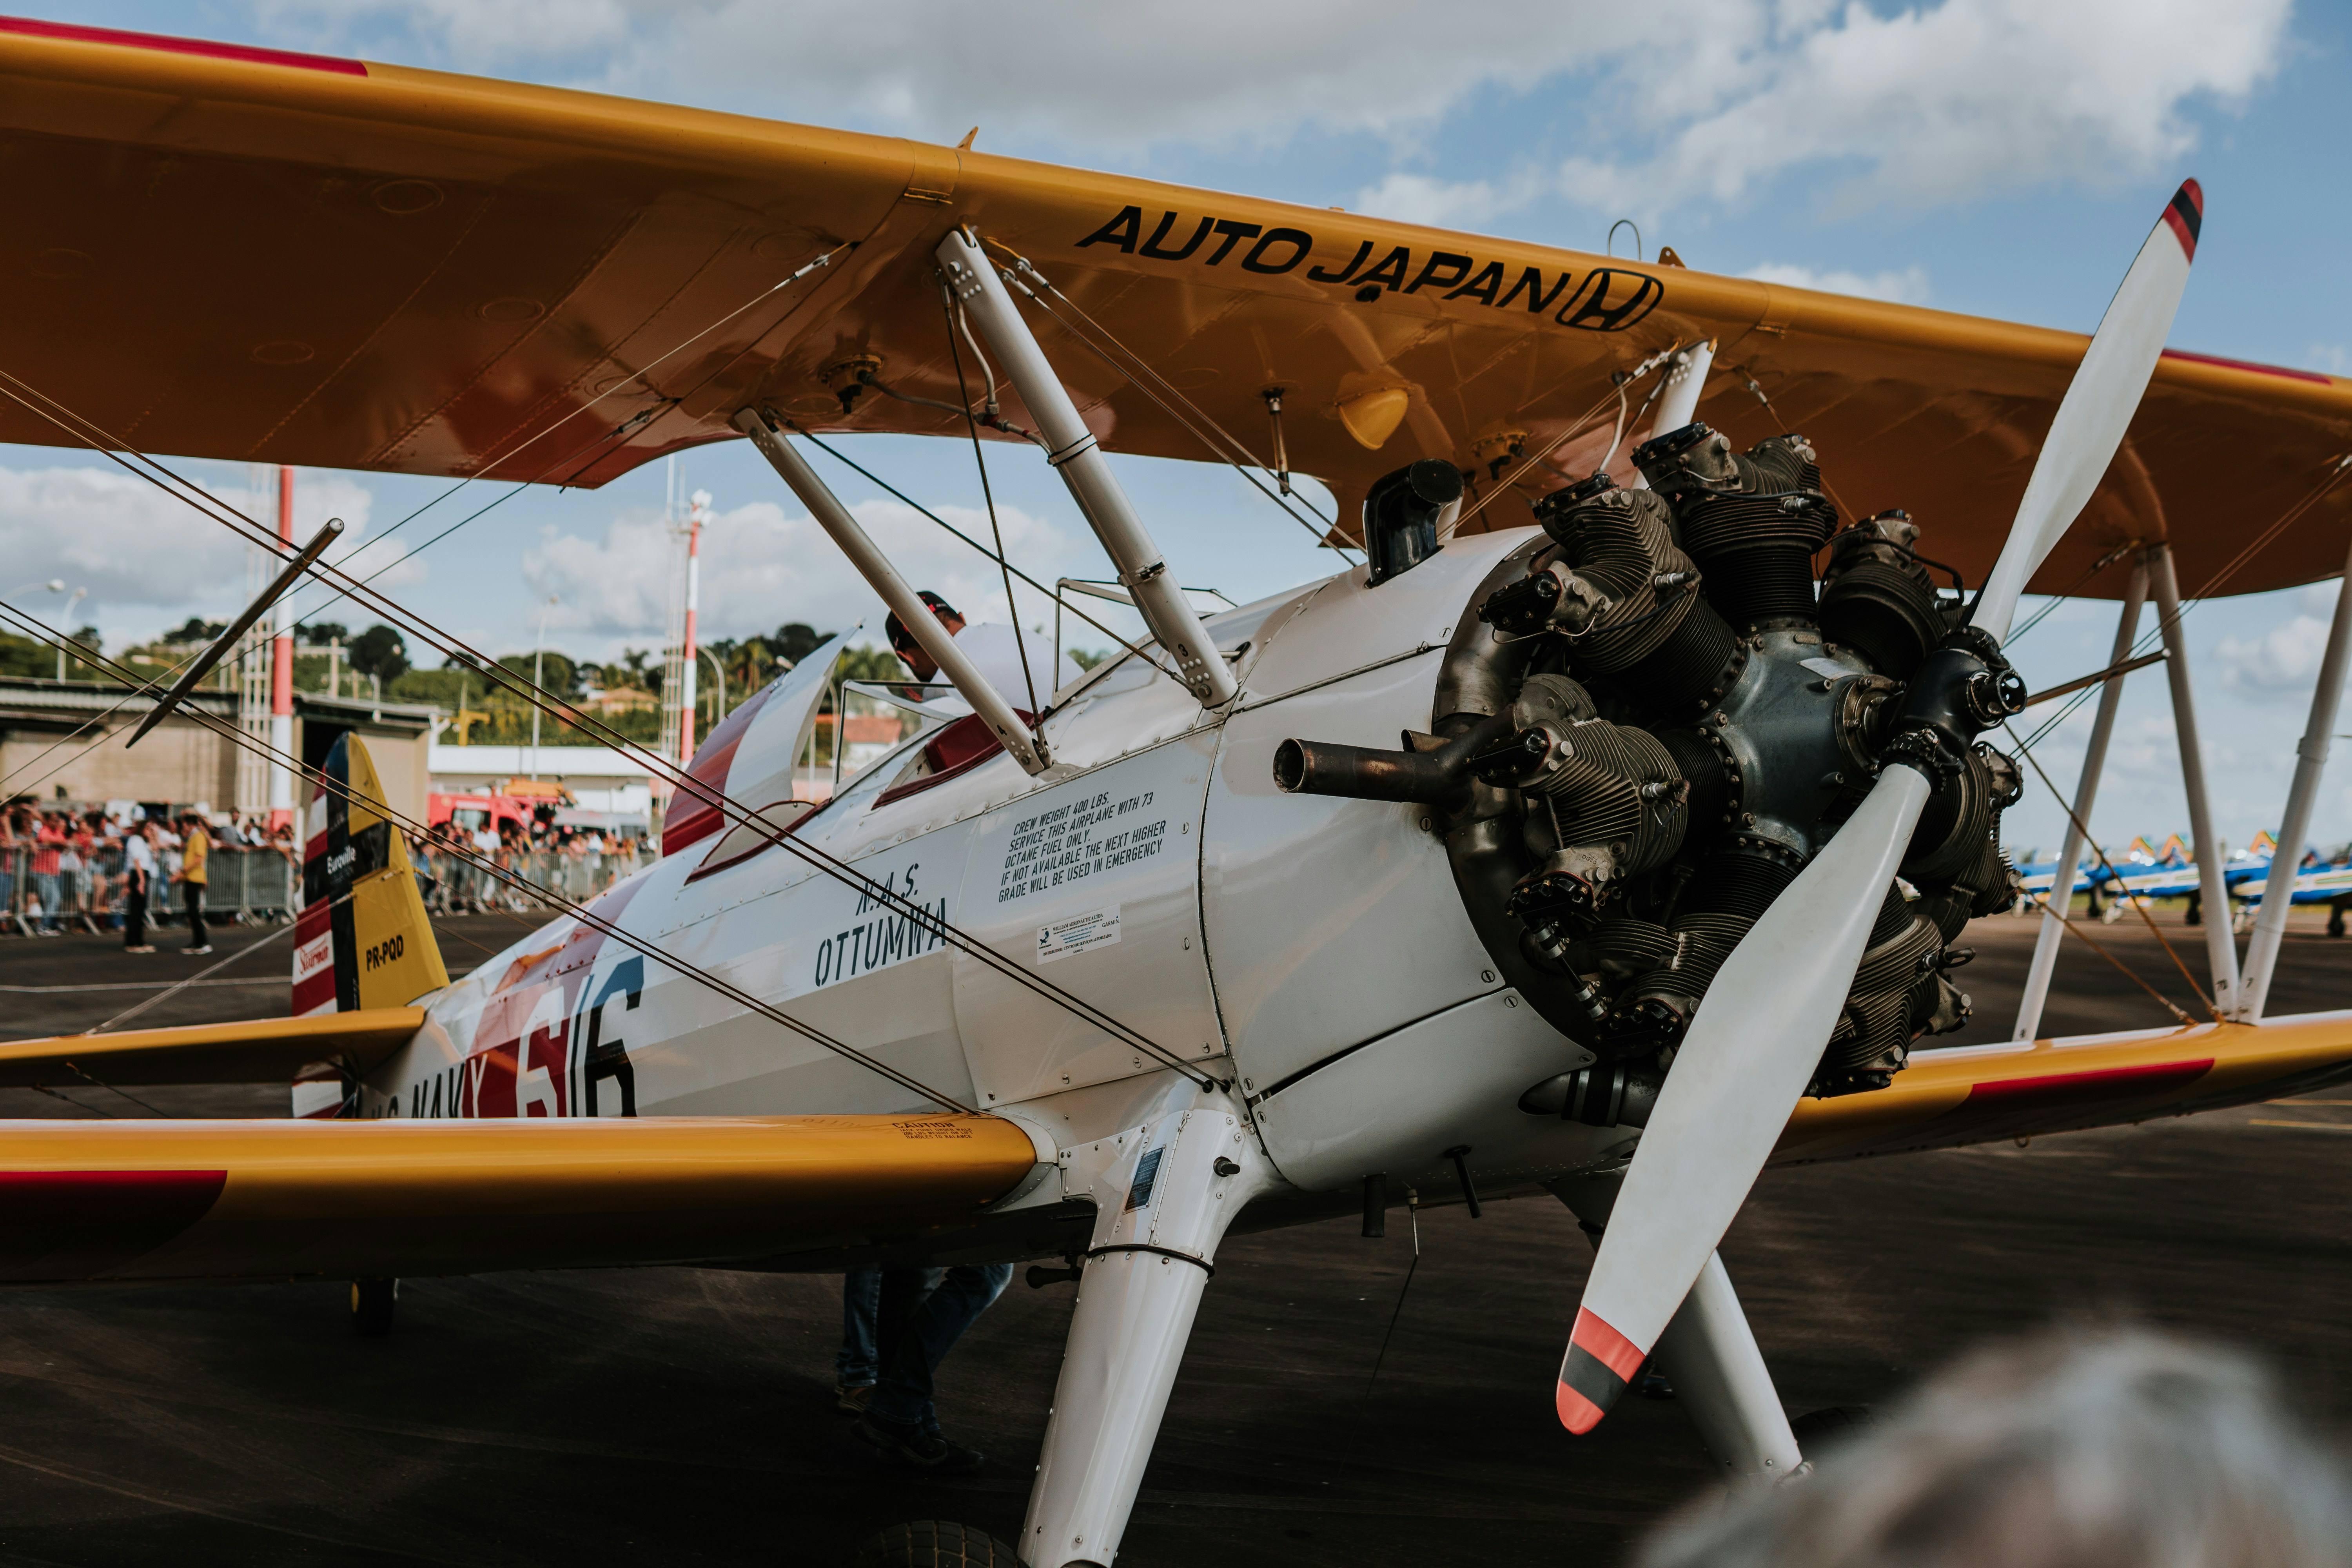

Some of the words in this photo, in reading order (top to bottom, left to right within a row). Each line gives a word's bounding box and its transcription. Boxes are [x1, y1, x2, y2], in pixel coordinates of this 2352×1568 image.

[1074, 205, 1313, 275] AUTO
[1307, 241, 1572, 314] JAPAN
[1009, 829, 1045, 852] SERVICE
[1048, 821, 1067, 839] THIS
[1069, 804, 1115, 832] AIRPLANE
[1118, 796, 1140, 815] WITH
[1142, 792, 1153, 807] 73
[1013, 817, 1038, 836] CREW
[1039, 805, 1071, 827] WEIGHT
[1073, 799, 1089, 815] 400
[1091, 792, 1109, 809] LBS.
[999, 882, 1027, 903] GRADE
[1030, 875, 1048, 893] WILL
[1052, 870, 1064, 886] BE
[1067, 862, 1090, 881] USED
[1093, 857, 1103, 873] IN
[1106, 838, 1163, 869] EMERGENCY
[1001, 871, 1010, 886] IF
[1012, 865, 1029, 882] NOT
[1031, 848, 1082, 876] AVAILABLE
[1085, 841, 1102, 859] THE
[1105, 832, 1129, 852] NEXT
[1132, 820, 1166, 844] HIGHER
[1005, 846, 1039, 869] OCTANE
[1041, 838, 1062, 857] FUEL
[1066, 829, 1090, 848] ONLY.
[815, 897, 946, 987] OTTUMWA
[1053, 923, 1069, 931] WILLIAM
[1069, 916, 1094, 927] AERONÁUTICA
[1102, 919, 1119, 927] GARMIN
[367, 935, 404, 973] PR-PQD
[1043, 947, 1062, 956] DISTRIBUIDOR
